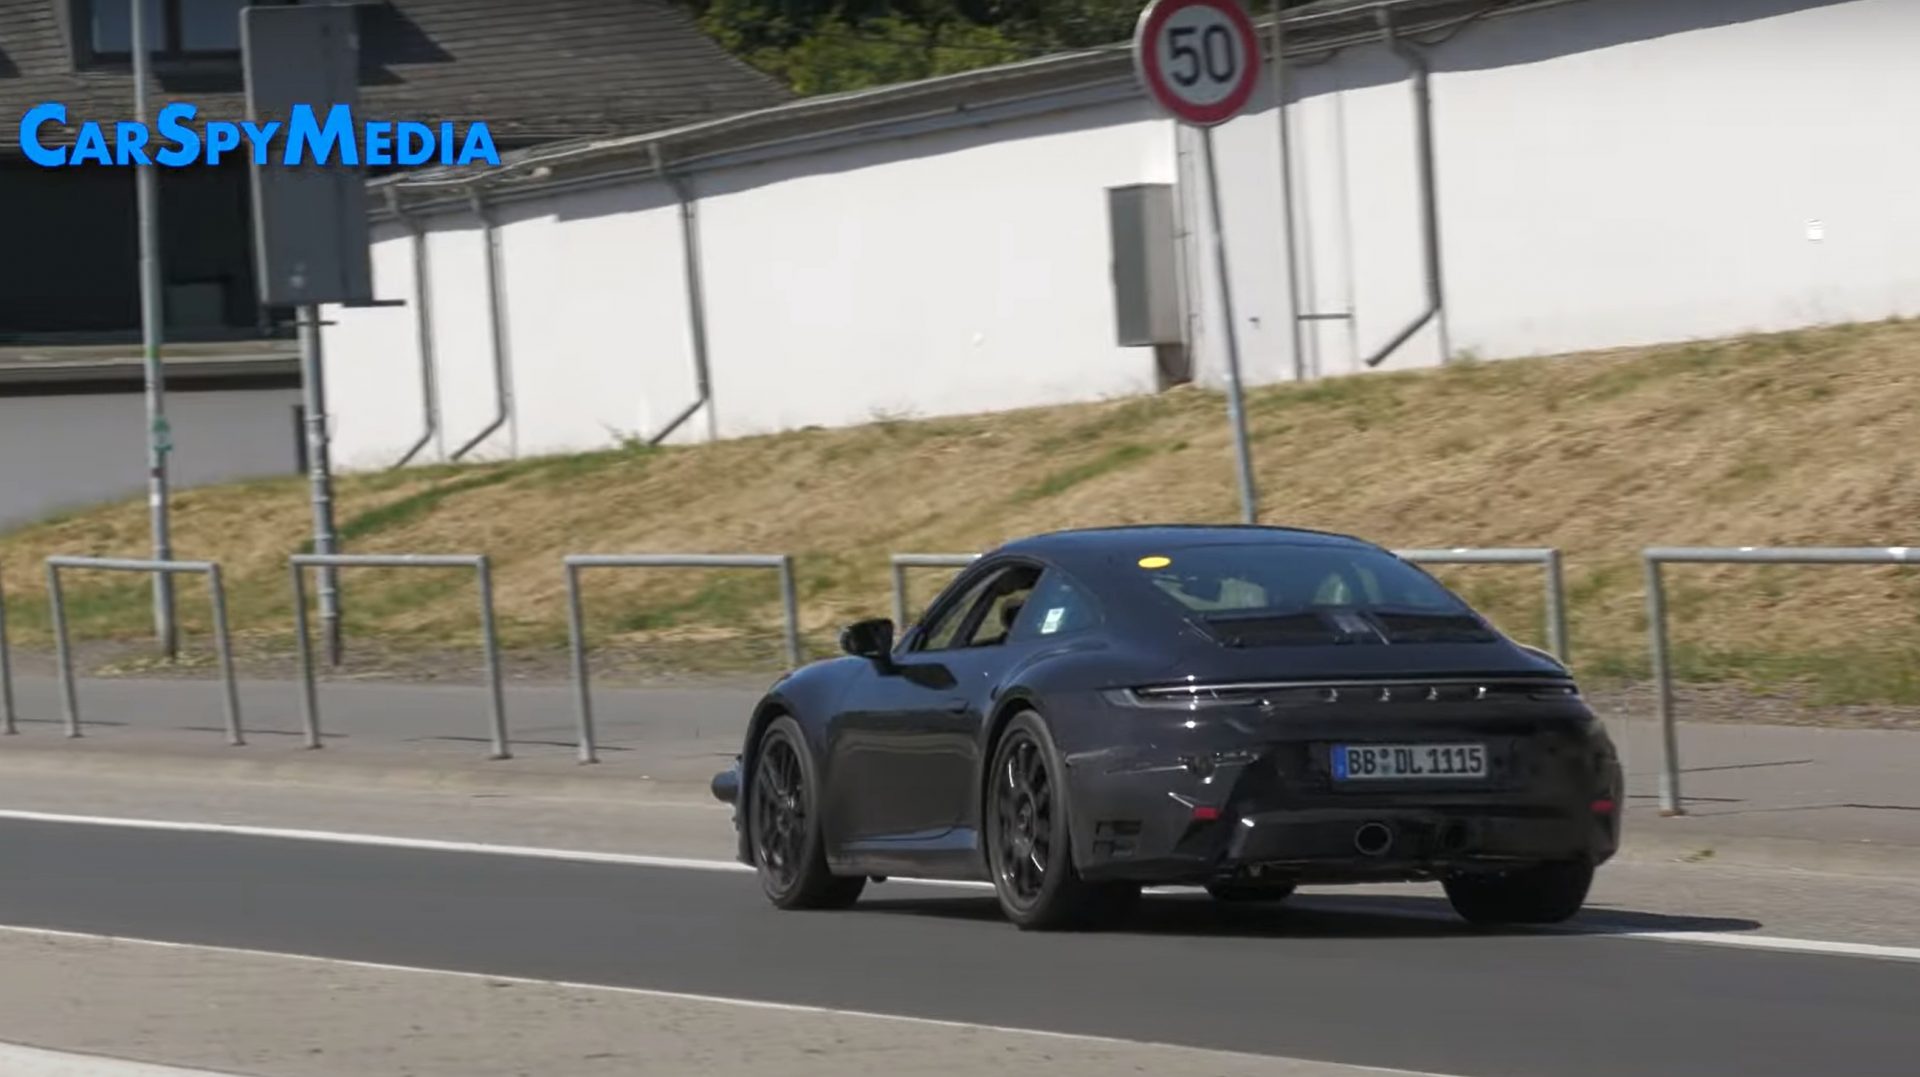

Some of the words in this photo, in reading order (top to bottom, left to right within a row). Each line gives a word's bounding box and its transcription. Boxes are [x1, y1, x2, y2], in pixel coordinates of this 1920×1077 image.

[1168, 24, 1236, 86] 50
[1349, 749, 1376, 775] BB
[1395, 748, 1422, 774] DL
[1427, 747, 1482, 774] 1115
